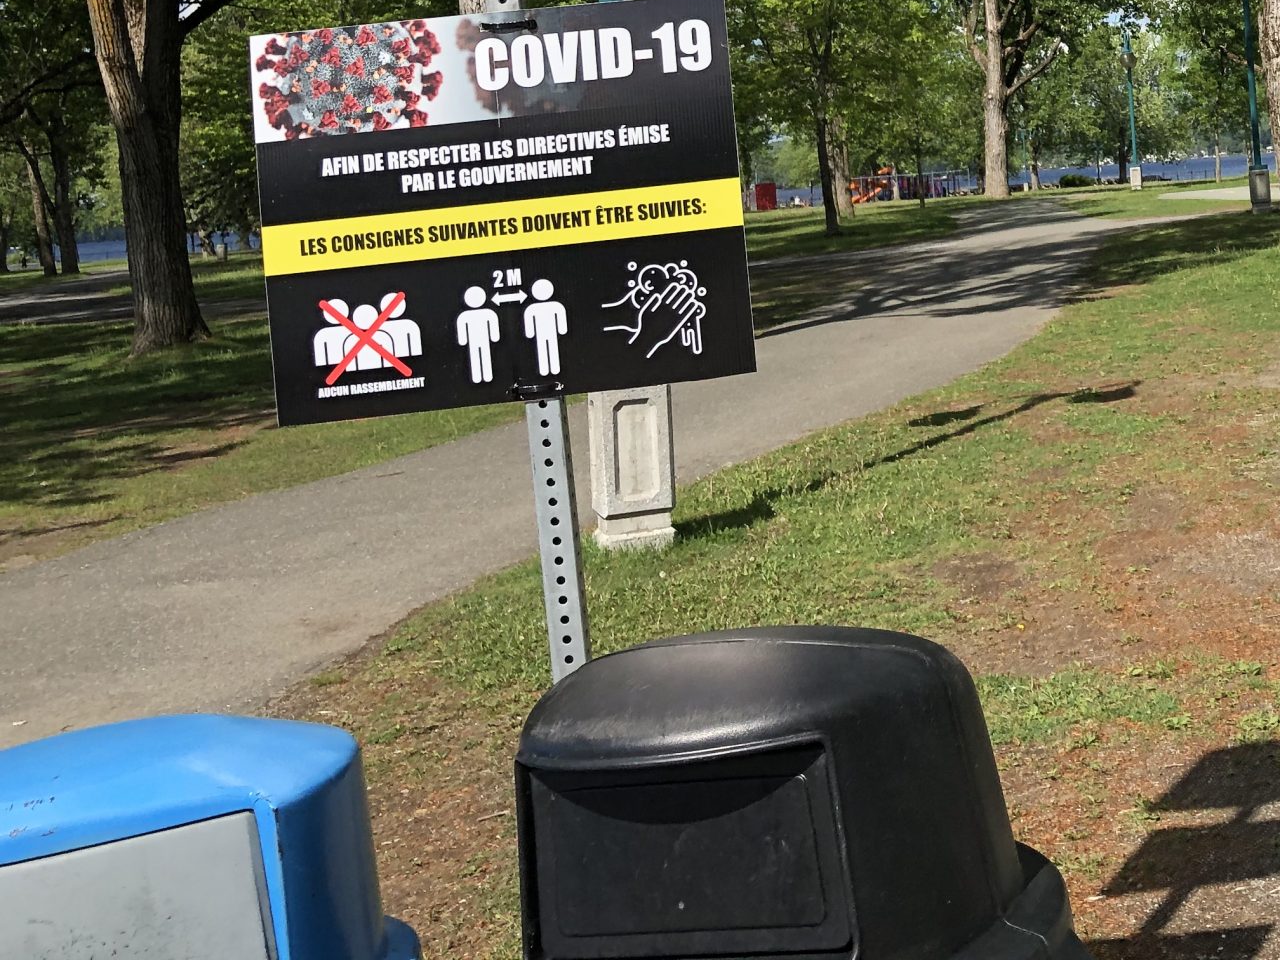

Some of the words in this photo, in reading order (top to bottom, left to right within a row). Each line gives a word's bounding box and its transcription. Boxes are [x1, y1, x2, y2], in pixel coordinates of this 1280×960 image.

[475, 19, 713, 91] COVID-19
[322, 155, 360, 176] AFIN
[363, 152, 385, 172] DE
[388, 143, 481, 170] RESPECTER
[484, 140, 514, 160] LES
[517, 129, 616, 157] DIRECTIVES
[618, 123, 671, 147] ÉMISE
[402, 173, 435, 193] PAR
[438, 171, 457, 190] LE
[459, 156, 594, 188] GOUVERNEMENT
[300, 237, 328, 256] LES
[331, 227, 424, 253] CONSIGNES
[428, 217, 518, 243] SUIVANTES
[522, 209, 592, 234] DOIVENT
[596, 205, 634, 225] ÊTRE
[637, 198, 707, 221] SUIVIES:
[492, 269, 504, 288] 2
[506, 268, 522, 287] M
[318, 385, 350, 399] AUCUN
[350, 377, 425, 395] RASSEMBLEMENT
